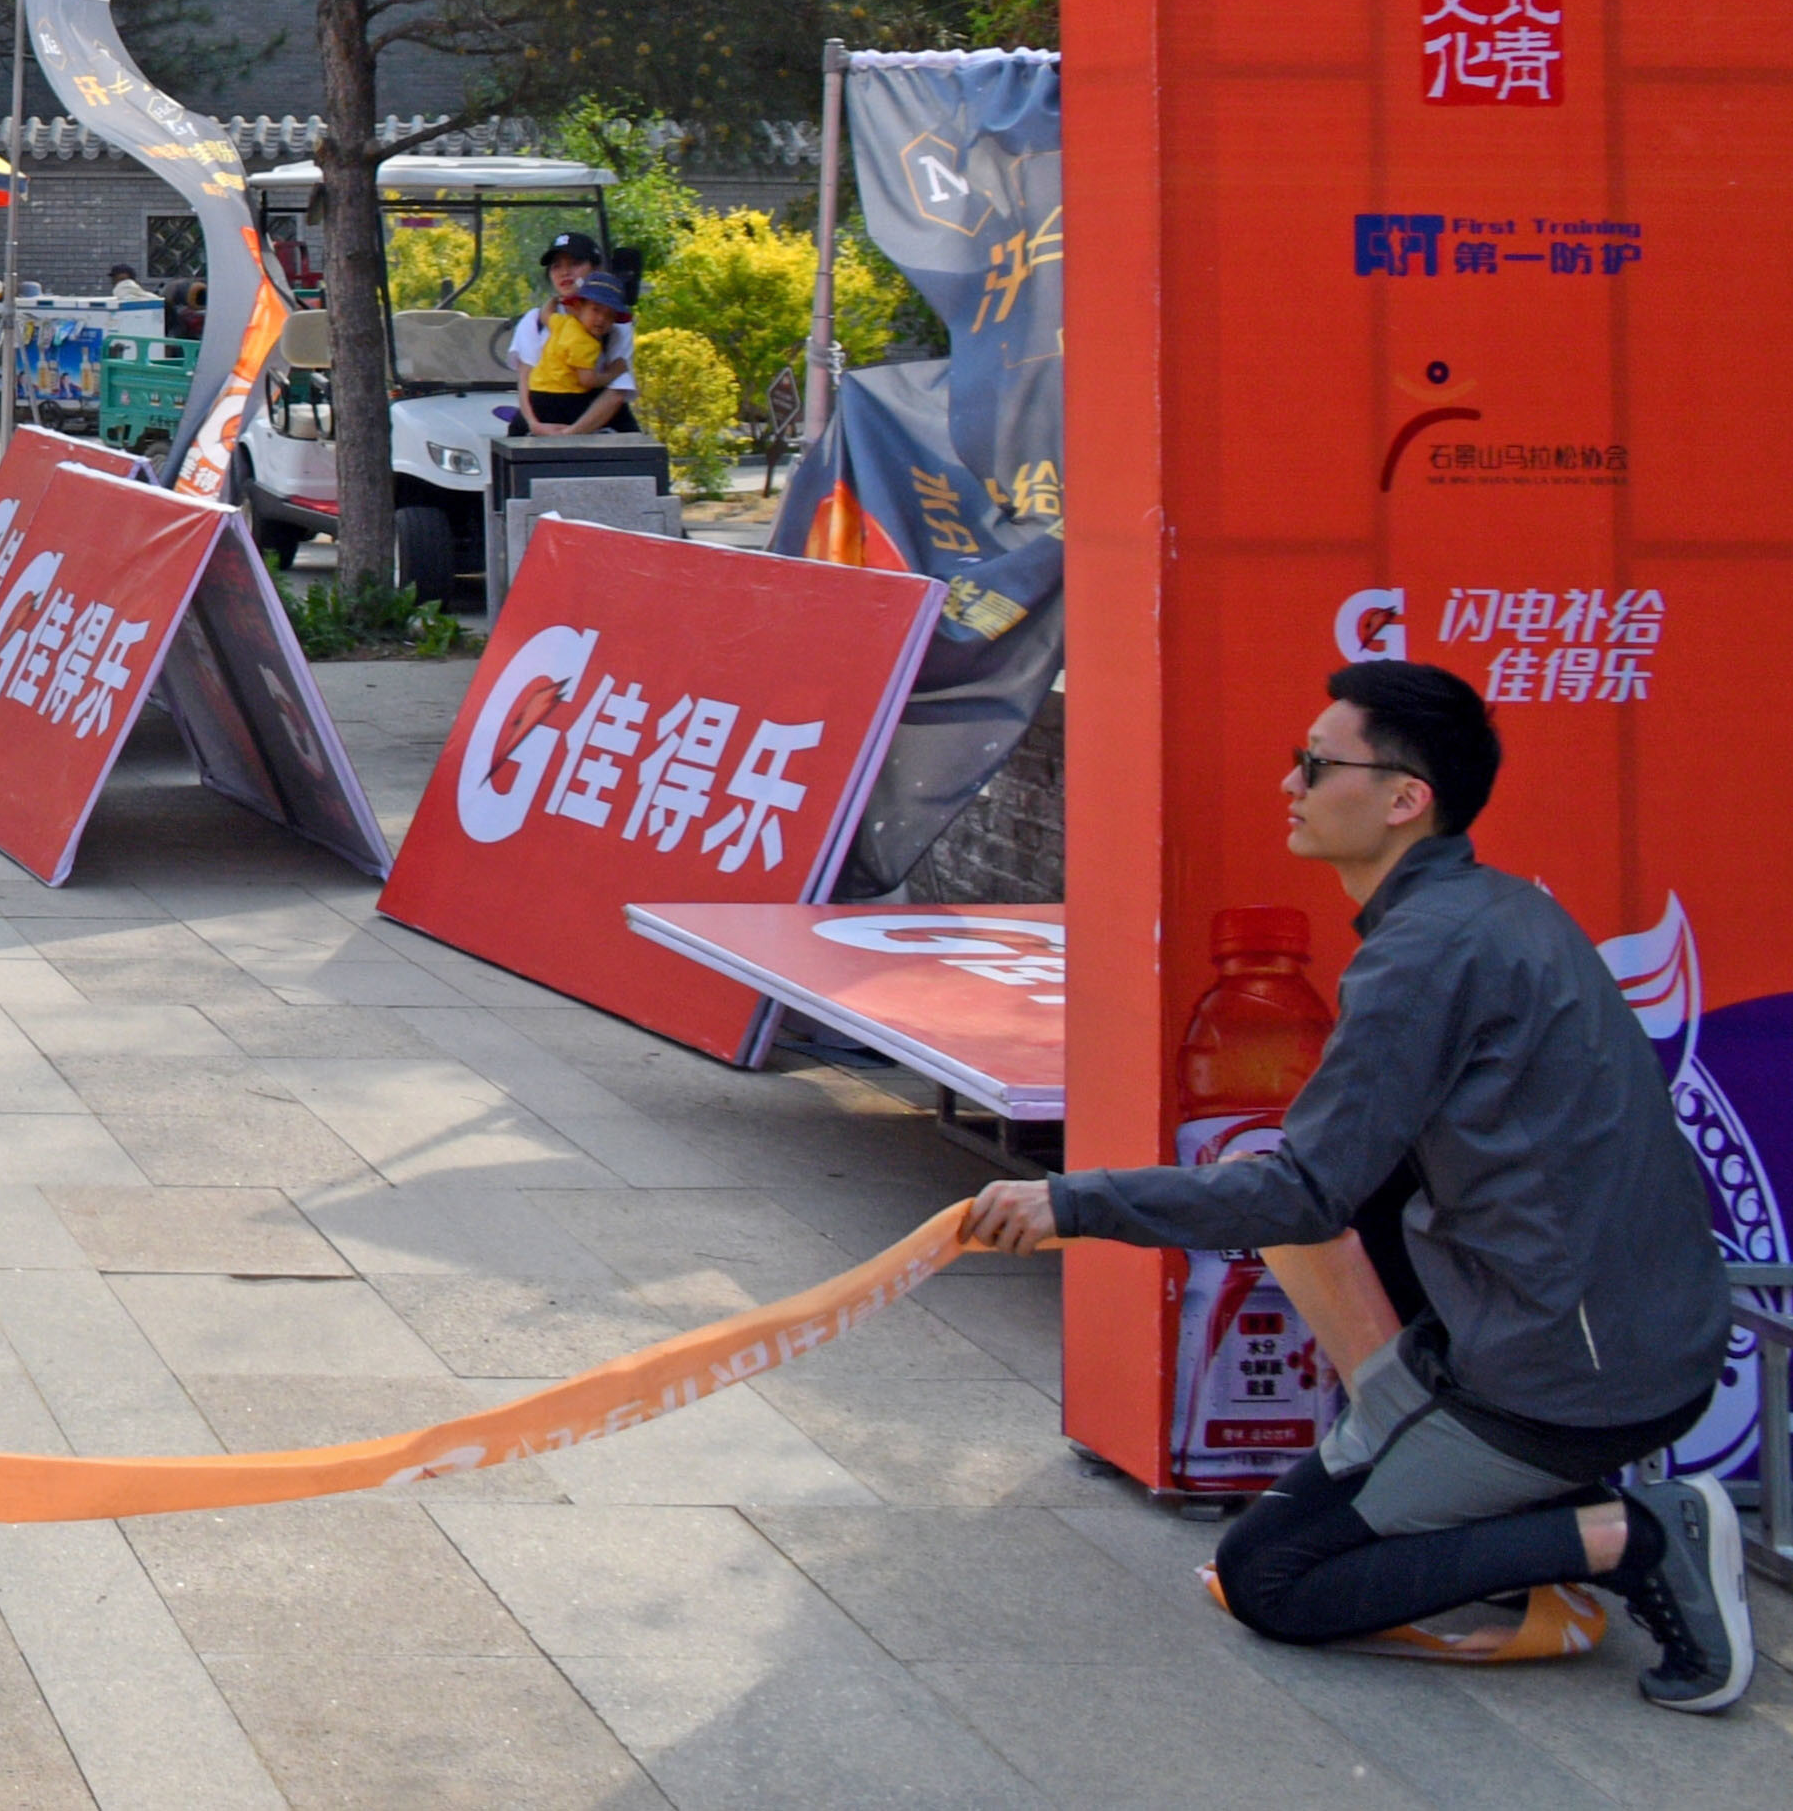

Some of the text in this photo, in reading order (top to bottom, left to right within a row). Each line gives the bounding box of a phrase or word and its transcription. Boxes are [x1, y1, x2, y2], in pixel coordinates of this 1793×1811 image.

[1454, 242, 1642, 274] 第一防护
[1437, 588, 1666, 651] 闪电补给
[5, 587, 150, 740] 佳得乐
[1484, 648, 1654, 703] 佳得乐
[545, 674, 824, 876] 佳得乐
